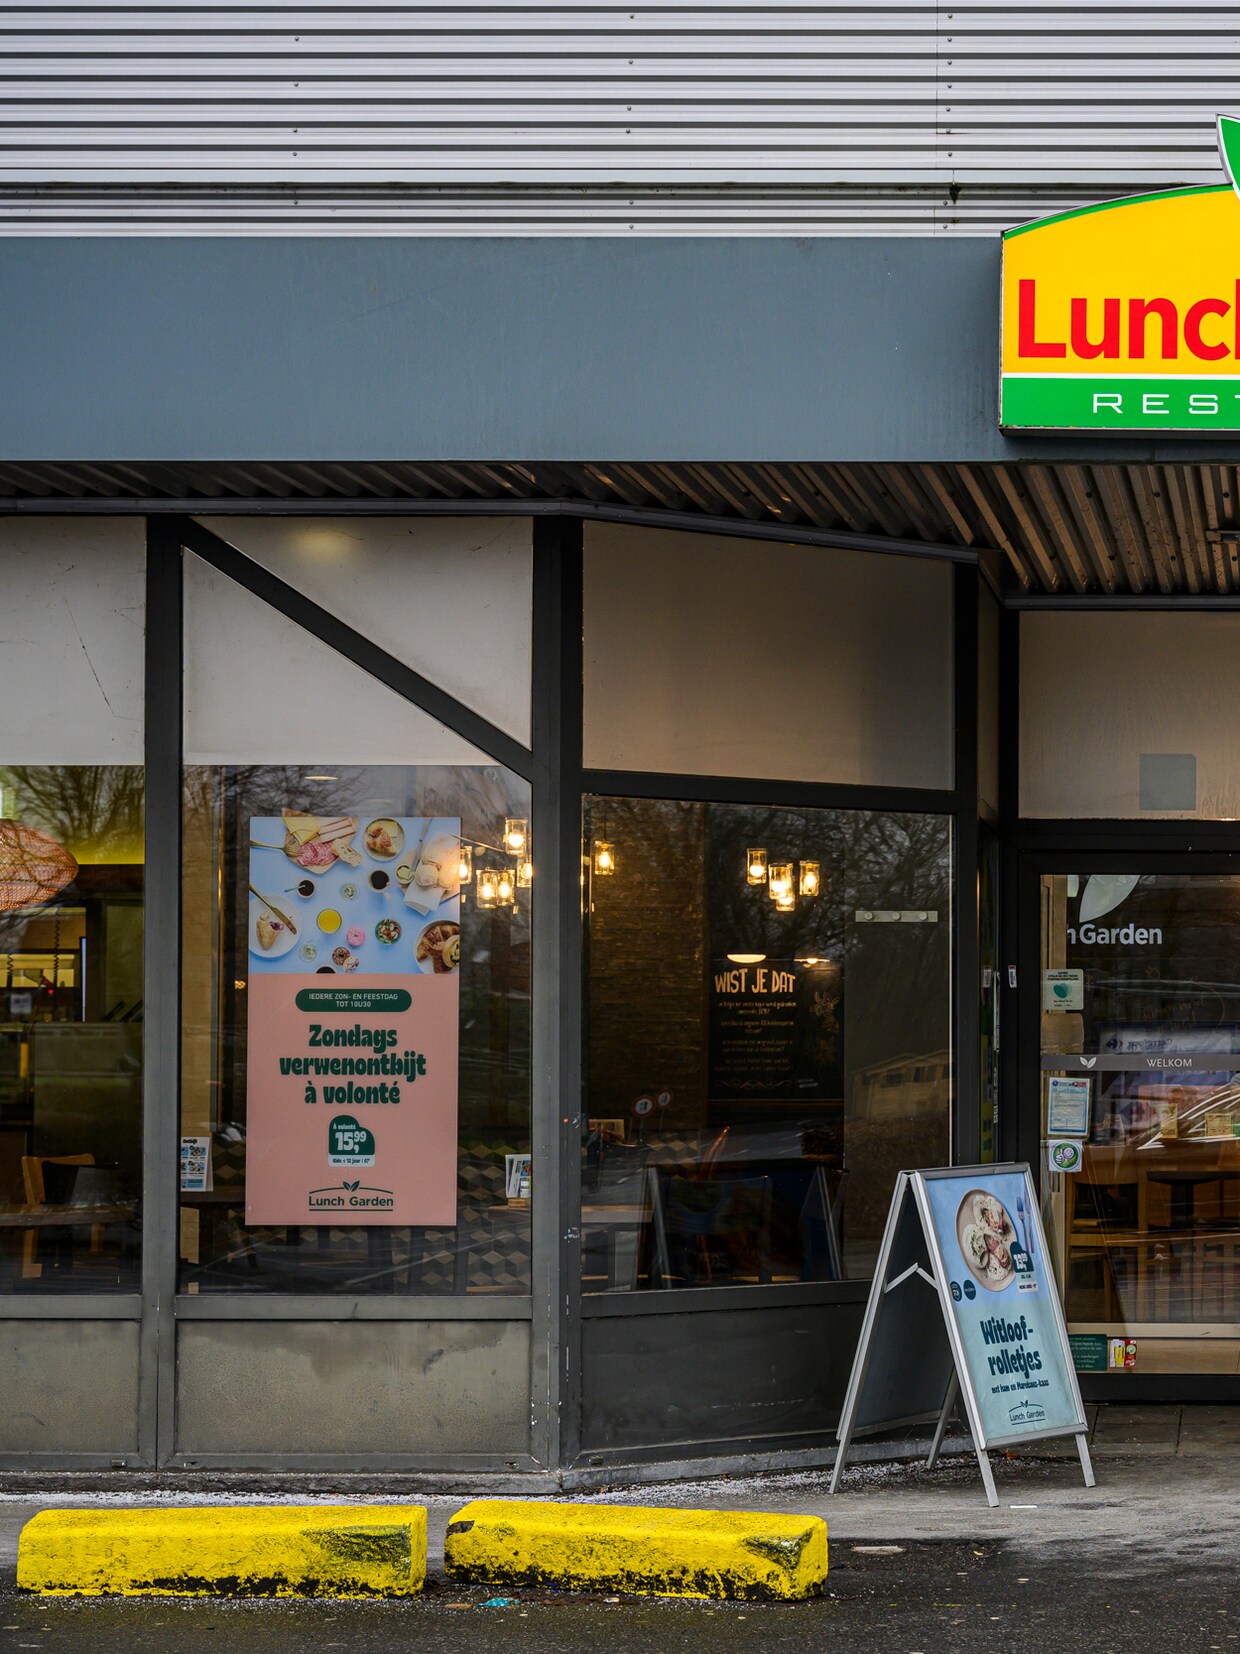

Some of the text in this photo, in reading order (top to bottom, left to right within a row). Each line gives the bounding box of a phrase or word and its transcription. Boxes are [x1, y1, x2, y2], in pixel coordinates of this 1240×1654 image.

[1079, 923, 1163, 945] Garden
[714, 968, 796, 994] WIST JE DAT
[308, 1024, 398, 1054] Zondags
[279, 1050, 427, 1083] verwenontbijt
[1146, 1058, 1192, 1067] WELKOM
[304, 1080, 400, 1104] à volonté
[308, 1196, 394, 1207] Lunch Garden
[980, 1315, 1034, 1345] Witloof-
[987, 1344, 1042, 1379] rolletjes
[991, 1385, 1000, 1394] met
[1000, 1383, 1010, 1392] ham
[1009, 1409, 1046, 1421] Lunch Garden
